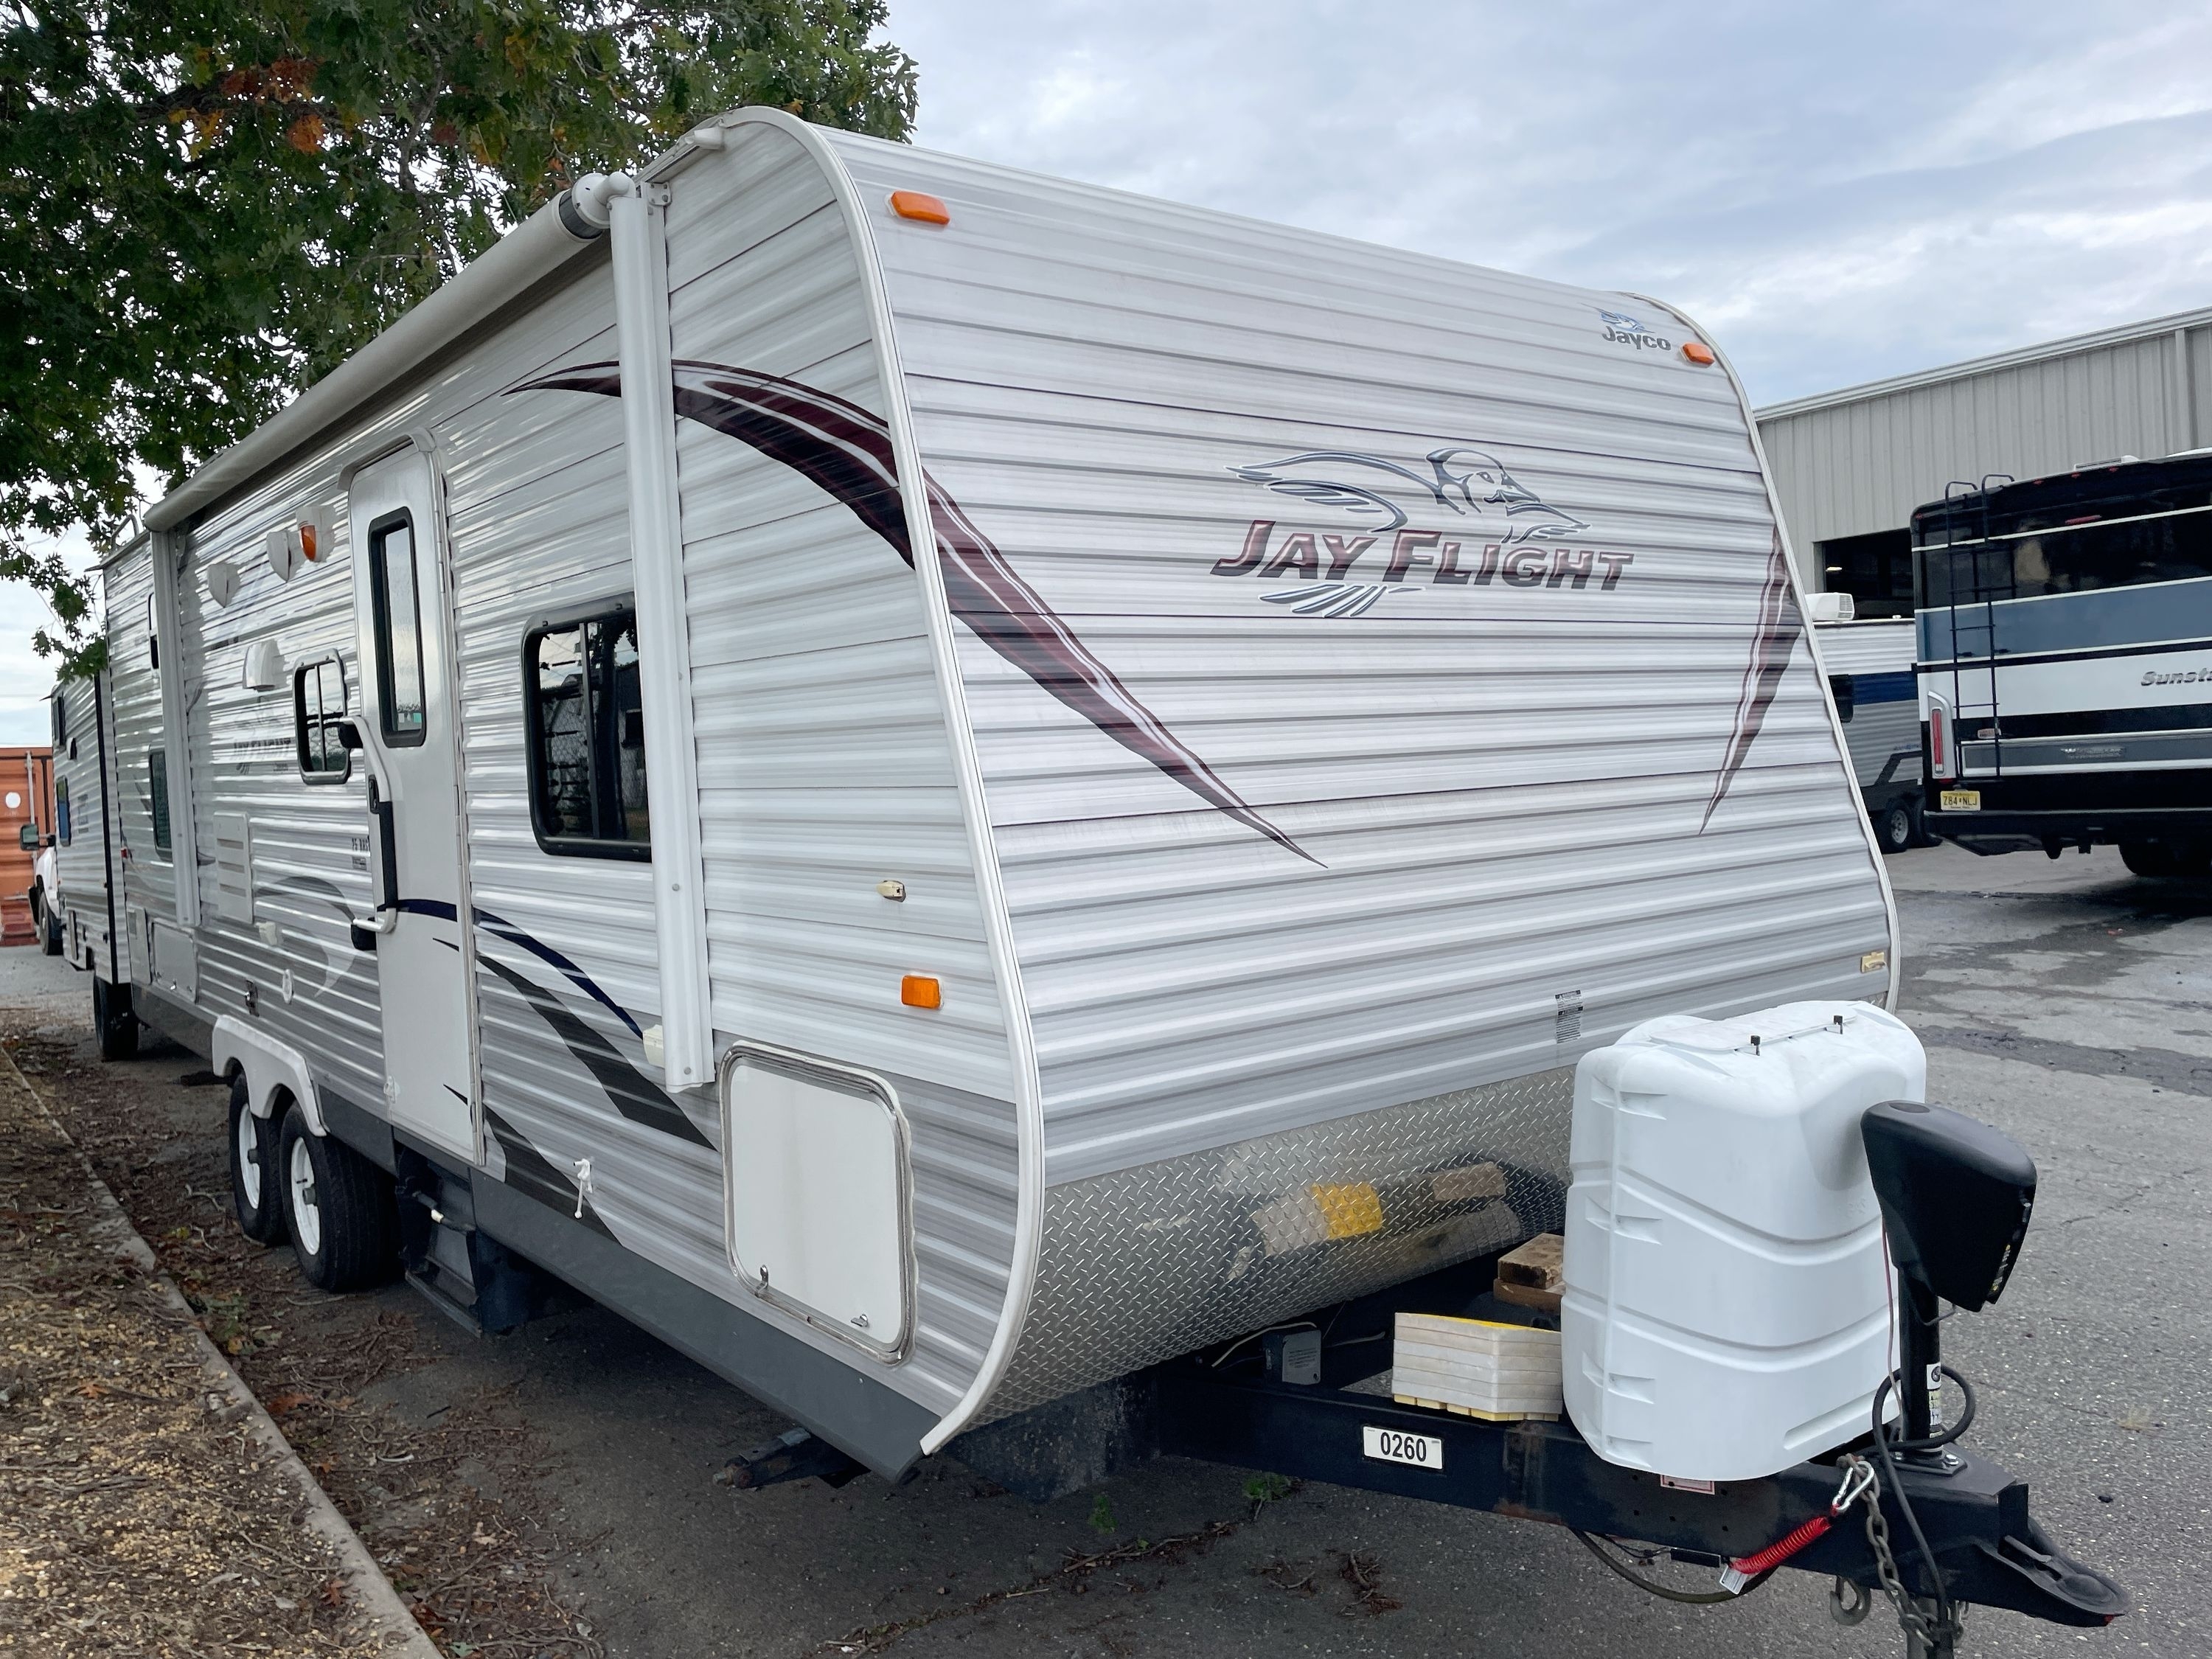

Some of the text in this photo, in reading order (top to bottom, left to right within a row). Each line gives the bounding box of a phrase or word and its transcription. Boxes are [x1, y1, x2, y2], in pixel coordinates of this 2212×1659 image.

[1601, 325, 1672, 351] Jayco
[1211, 520, 1634, 591] JAY FLIGHT
[1380, 1432, 1427, 1462] 0260
